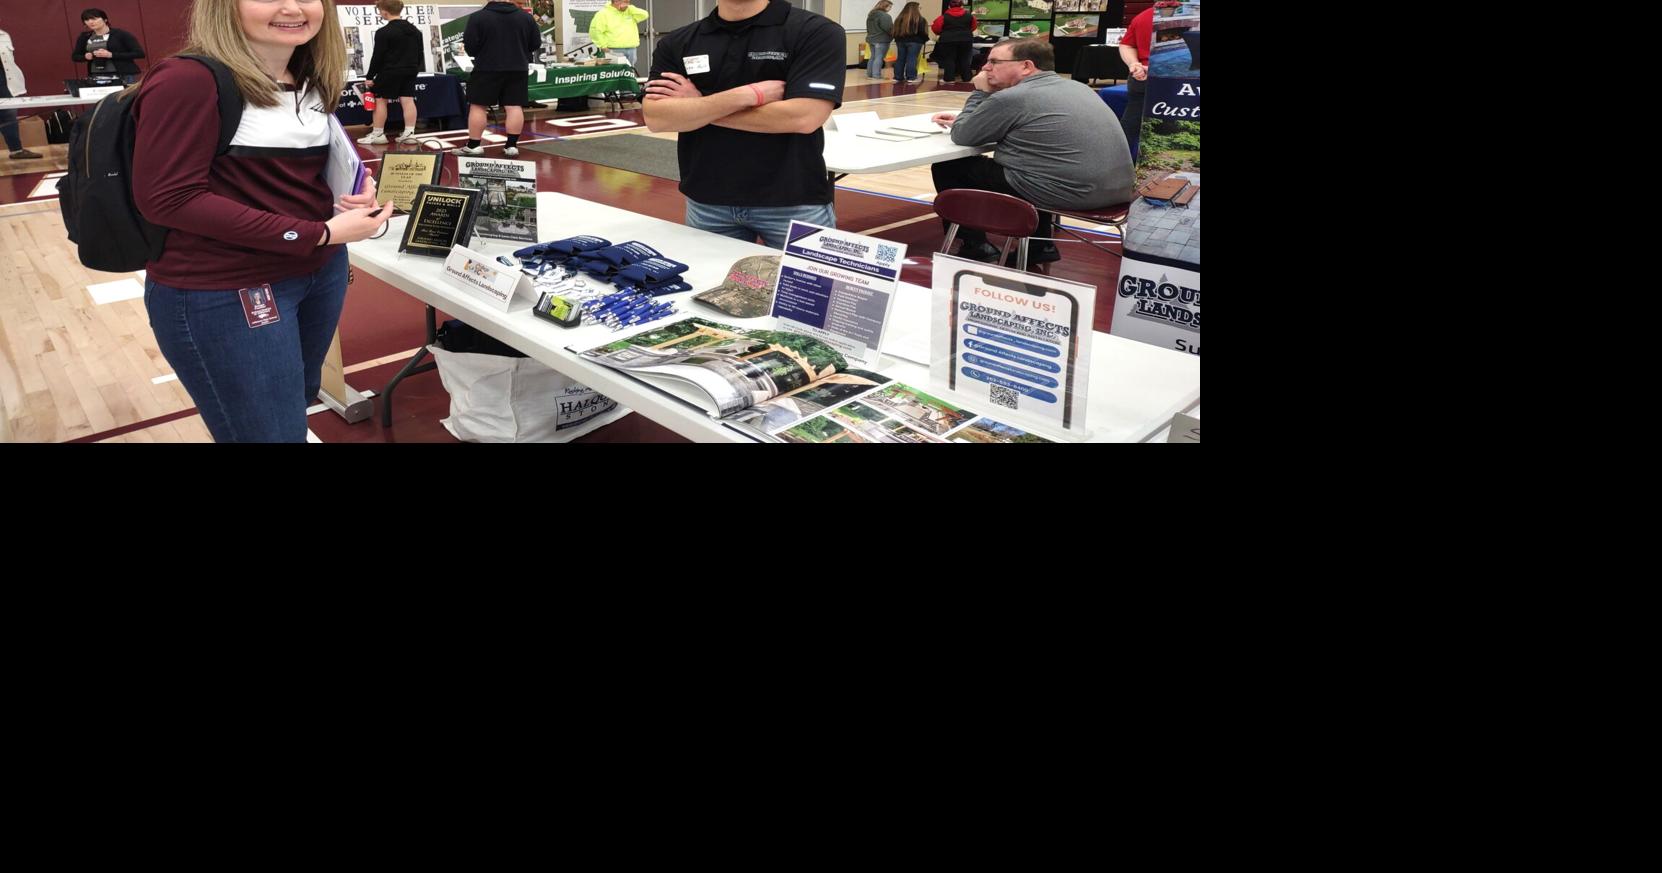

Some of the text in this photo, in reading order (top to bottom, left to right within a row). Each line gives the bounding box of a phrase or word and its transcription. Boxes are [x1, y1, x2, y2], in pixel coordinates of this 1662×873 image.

[345, 5, 434, 16] VOLUTEER
[355, 16, 432, 26] SERCES
[554, 73, 598, 85] Inspiring
[426, 196, 462, 205] UNILOCK
[802, 248, 838, 263] Landscape
[839, 257, 880, 273] Technicians
[446, 265, 462, 278] Ground
[462, 271, 479, 286] Affects
[478, 281, 508, 300] Landscaping
[830, 270, 854, 282] GROWING
[855, 277, 870, 285] TEAM
[974, 287, 1056, 313] FOLLOW US!
[960, 301, 1012, 318] GROUND
[1012, 313, 1070, 337] AFFECTS
